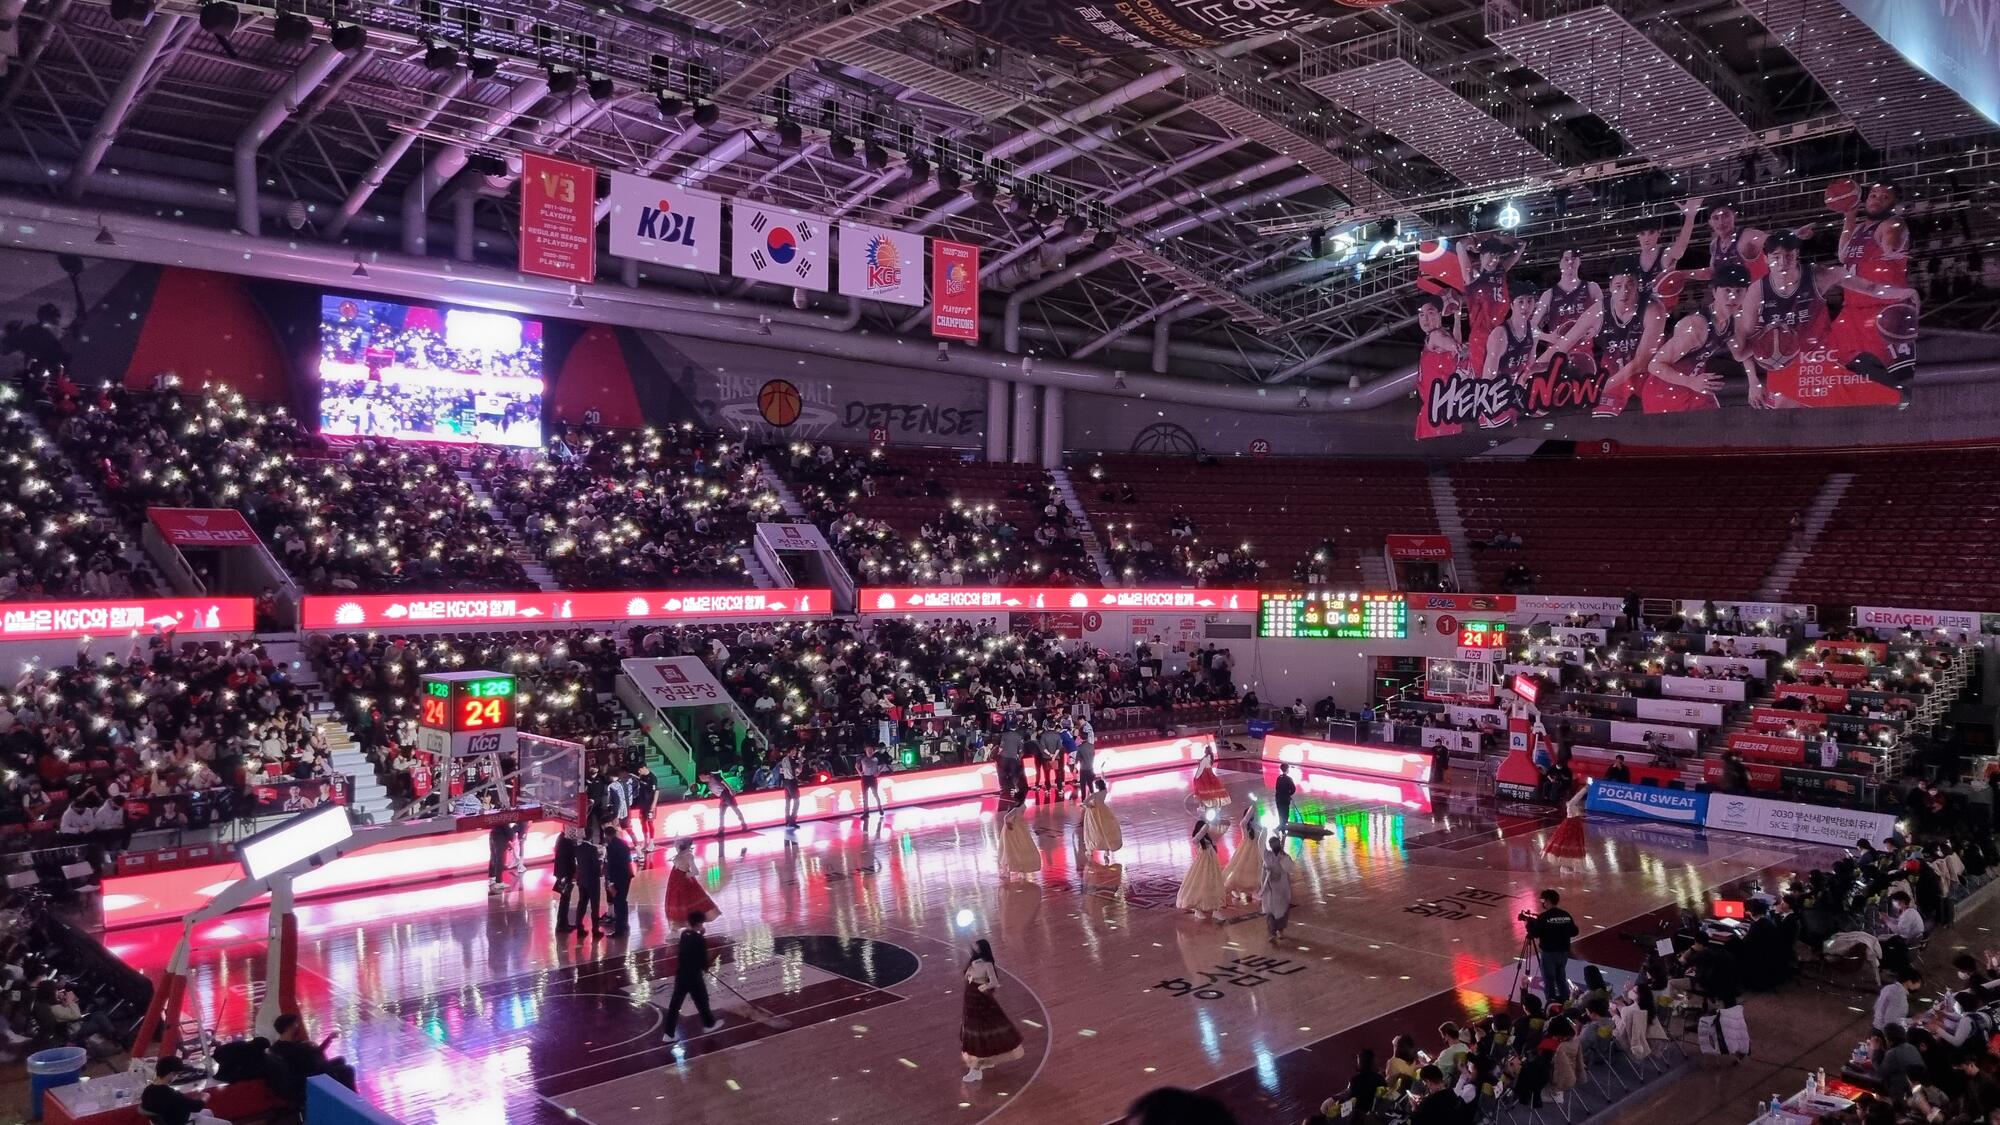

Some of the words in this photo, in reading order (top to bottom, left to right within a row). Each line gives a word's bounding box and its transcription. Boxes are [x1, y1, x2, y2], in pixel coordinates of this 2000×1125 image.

[1115, 2, 1172, 38] EXTRACT
[540, 209, 577, 221] PLAYOFFS
[637, 205, 695, 247] KBL
[528, 226, 560, 237] REGULAR
[561, 233, 588, 243] SEASON
[543, 238, 579, 250] PLAYOFFS
[540, 258, 576, 269] PLAYOFFS
[867, 264, 901, 290] KGC
[946, 280, 966, 294] KGC
[942, 305, 969, 315] PLAYOFFS
[937, 315, 974, 329] CHAMPIONS
[1799, 350, 1838, 363] KGC
[1887, 343, 1911, 359] 14
[1799, 365, 1823, 375] PRO
[1799, 374, 1872, 386] BASKETBALL
[1798, 386, 1829, 397] CLUB
[1432, 378, 1509, 423] HERE
[842, 401, 983, 435] DEFENSE
[874, 429, 887, 440] 21
[1254, 441, 1267, 453] 22
[1602, 442, 1610, 453] 9
[711, 596, 743, 611] KGC와
[950, 592, 980, 606] KGC와
[1143, 592, 1174, 606] KGC와
[1578, 602, 1601, 610] YONG
[446, 600, 488, 618] KGC와
[54, 608, 109, 630] KGC와
[1089, 616, 1096, 627] 8
[1443, 620, 1449, 631] 1
[1865, 612, 1934, 626] CERAGEM
[1937, 615, 1972, 629] 세라젬
[1464, 632, 1482, 646] 24
[1492, 633, 1503, 646] 24
[1466, 650, 1481, 659] KCC
[652, 683, 717, 701] 정관장
[426, 700, 444, 725] 24
[465, 699, 502, 726] 24
[471, 735, 500, 752] KCC
[1598, 787, 1647, 802] POCARI
[1650, 794, 1696, 808] SWEAT
[1771, 809, 1794, 819] 2030
[1795, 812, 1858, 828] 부산세계박람회
[1858, 819, 1877, 831] 유치
[1792, 823, 1810, 833] 함께
[1812, 827, 1875, 842] 노력하겠습니다
